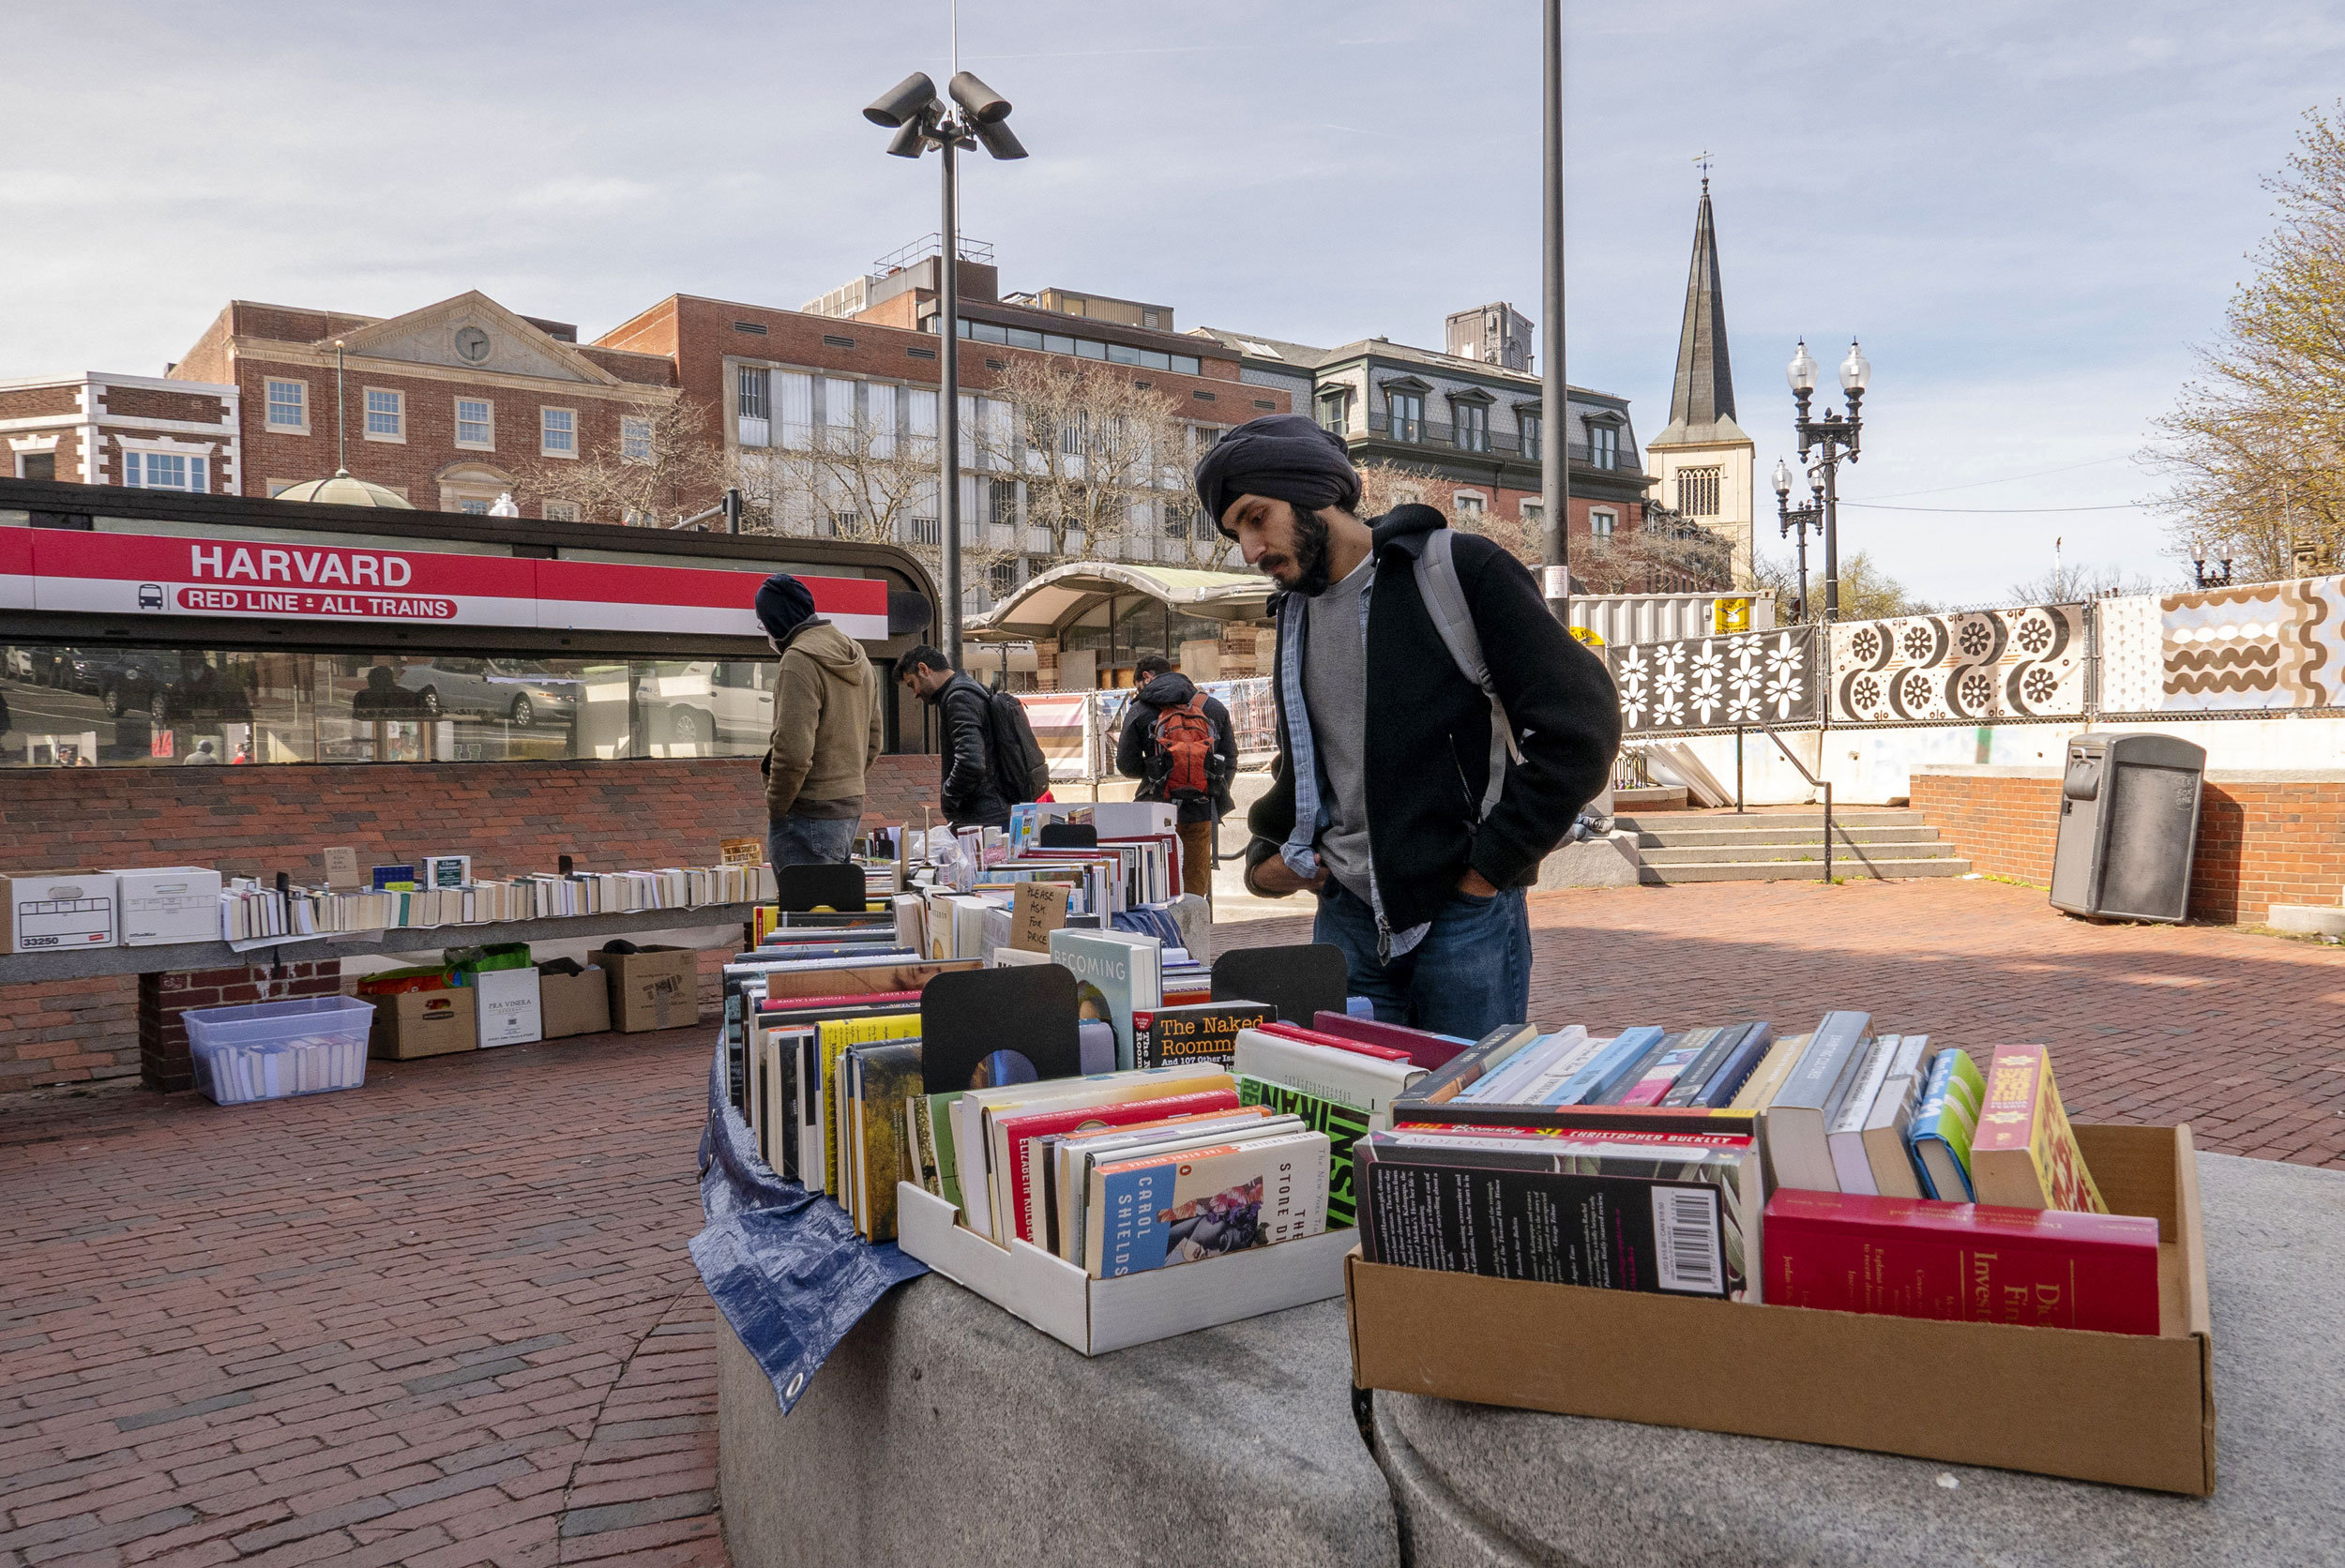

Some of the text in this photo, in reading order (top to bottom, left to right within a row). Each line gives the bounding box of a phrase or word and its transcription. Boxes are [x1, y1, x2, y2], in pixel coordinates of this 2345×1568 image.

[191, 545, 412, 587] HARVARD
[188, 591, 448, 617] RED LINE ALL TRAINS
[1027, 886, 1054, 901] PLEASE
[1031, 901, 1046, 914] ASK
[1029, 916, 1042, 927] FOR
[23, 936, 58, 946] 33250
[1027, 930, 1047, 945] PRICE
[1053, 950, 1126, 980] BECOMING
[1160, 1019, 1195, 1036] The
[1203, 1016, 1263, 1033] Naked
[1161, 1058, 1178, 1066] And
[1181, 1057, 1195, 1065] 107
[1197, 1055, 1221, 1064] Other
[1805, 1057, 1833, 1078] CULTURES
[1121, 1096, 1177, 1108] EXTINCTION
[1245, 1133, 1314, 1148] CAROL SHIELDS
[1411, 1135, 1520, 1149] MOLOKA'I
[1451, 1124, 1732, 1145] Boomsday CHRISTOPHER BUCKLEY
[1125, 1156, 1170, 1168] DIARIES
[1168, 1151, 1203, 1161] STONE
[1318, 1148, 1326, 1167] The
[1020, 1138, 1032, 1195] ELIZABETH
[1278, 1163, 1292, 1216] STONE
[1138, 1177, 1152, 1238] CAROL
[1378, 1203, 1386, 1229] Hawaiian
[1024, 1198, 1035, 1245] KOLBER
[1293, 1209, 1306, 1240] THE
[1115, 1195, 1131, 1275] SHIELDS
